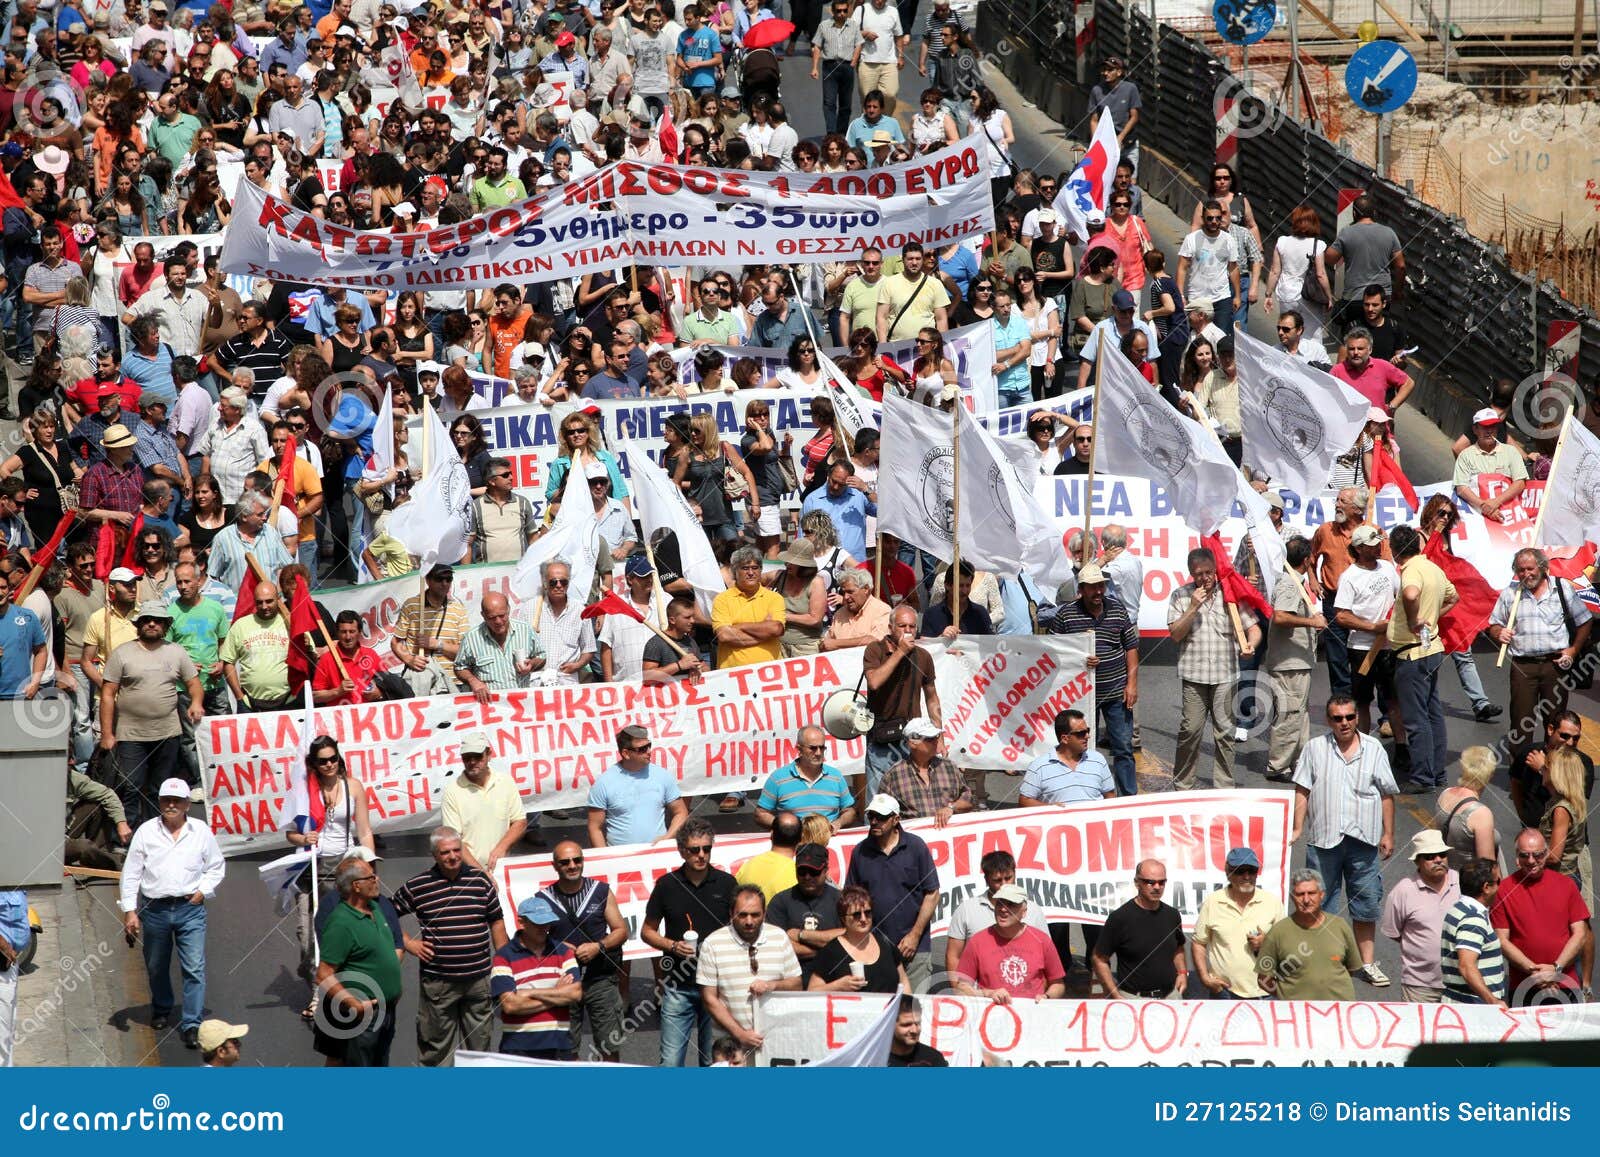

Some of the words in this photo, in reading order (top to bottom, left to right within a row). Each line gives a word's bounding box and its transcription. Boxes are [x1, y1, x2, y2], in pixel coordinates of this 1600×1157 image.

[258, 194, 549, 259] ΚΑΤΩΤΕΡΟΣ
[561, 161, 752, 208] ΜΙΣΘΟΣ
[904, 146, 980, 196] ΕΥΡΩ
[733, 201, 880, 234] 35ωρο
[406, 255, 553, 286] ΙΔΙΩΤΙΚΩΝ
[562, 239, 726, 268] ΥΠΑΛΛΗΛΩΝ
[737, 240, 765, 256] Ν.
[775, 214, 983, 255] ΘΕΣΣΑΛΟΝΙΚΗΣ
[1054, 478, 1133, 518] ΝΕΑ
[942, 652, 1007, 752] ΥΝΔΙΚΑΤΟ
[211, 746, 390, 798] ΑΝΑΤΠΗ
[697, 689, 867, 736] ΠΟΛΙΤΙΚ
[511, 744, 689, 797] ΕΡΓΑΤΟΥ
[926, 812, 1265, 878] ΡΓΑΖΟΜΕΝΟΙ
[1220, 999, 1470, 1052] ΔΗΜΟΣΙΑ
